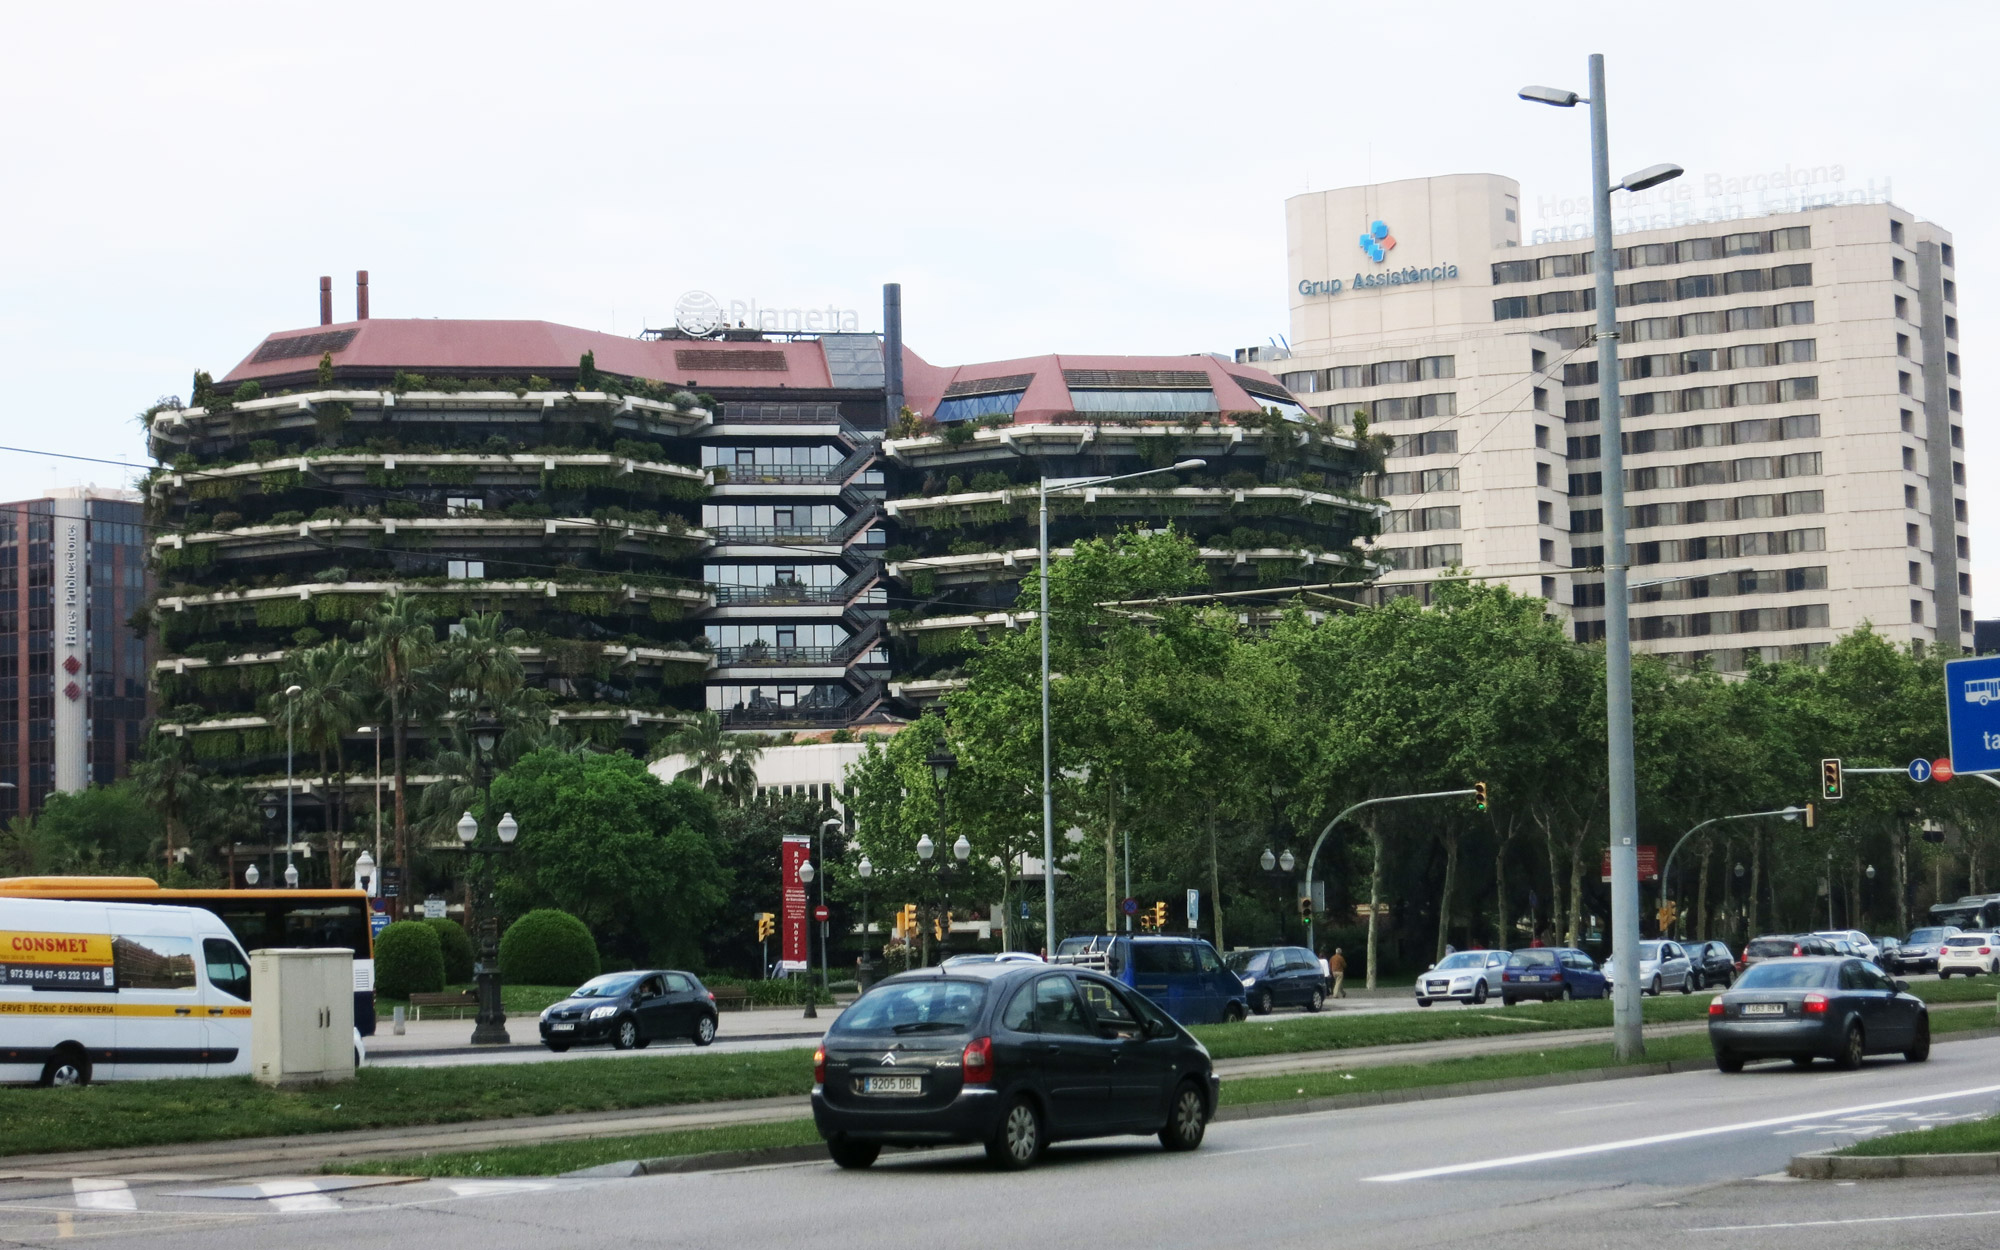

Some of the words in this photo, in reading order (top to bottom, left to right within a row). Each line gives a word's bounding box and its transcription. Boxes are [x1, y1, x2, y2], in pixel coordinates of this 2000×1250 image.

[1537, 189, 1648, 219] Hostal
[1658, 181, 1691, 203] de
[1703, 163, 1846, 198] Barcelona
[1298, 279, 1342, 296] Grup
[1352, 262, 1459, 290] Assistència
[729, 298, 859, 332] Planeta
[65, 524, 77, 606] Publicaciones
[65, 611, 77, 646] Heres
[12, 937, 88, 953] CONSMET
[10, 969, 23, 978] 972
[25, 969, 34, 979] 59
[34, 970, 43, 979] 64
[68, 971, 80, 980] 232
[82, 971, 90, 980] 12
[91, 971, 100, 980] 84
[872, 1078, 896, 1090] 9205
[899, 1078, 918, 1090] DBL
